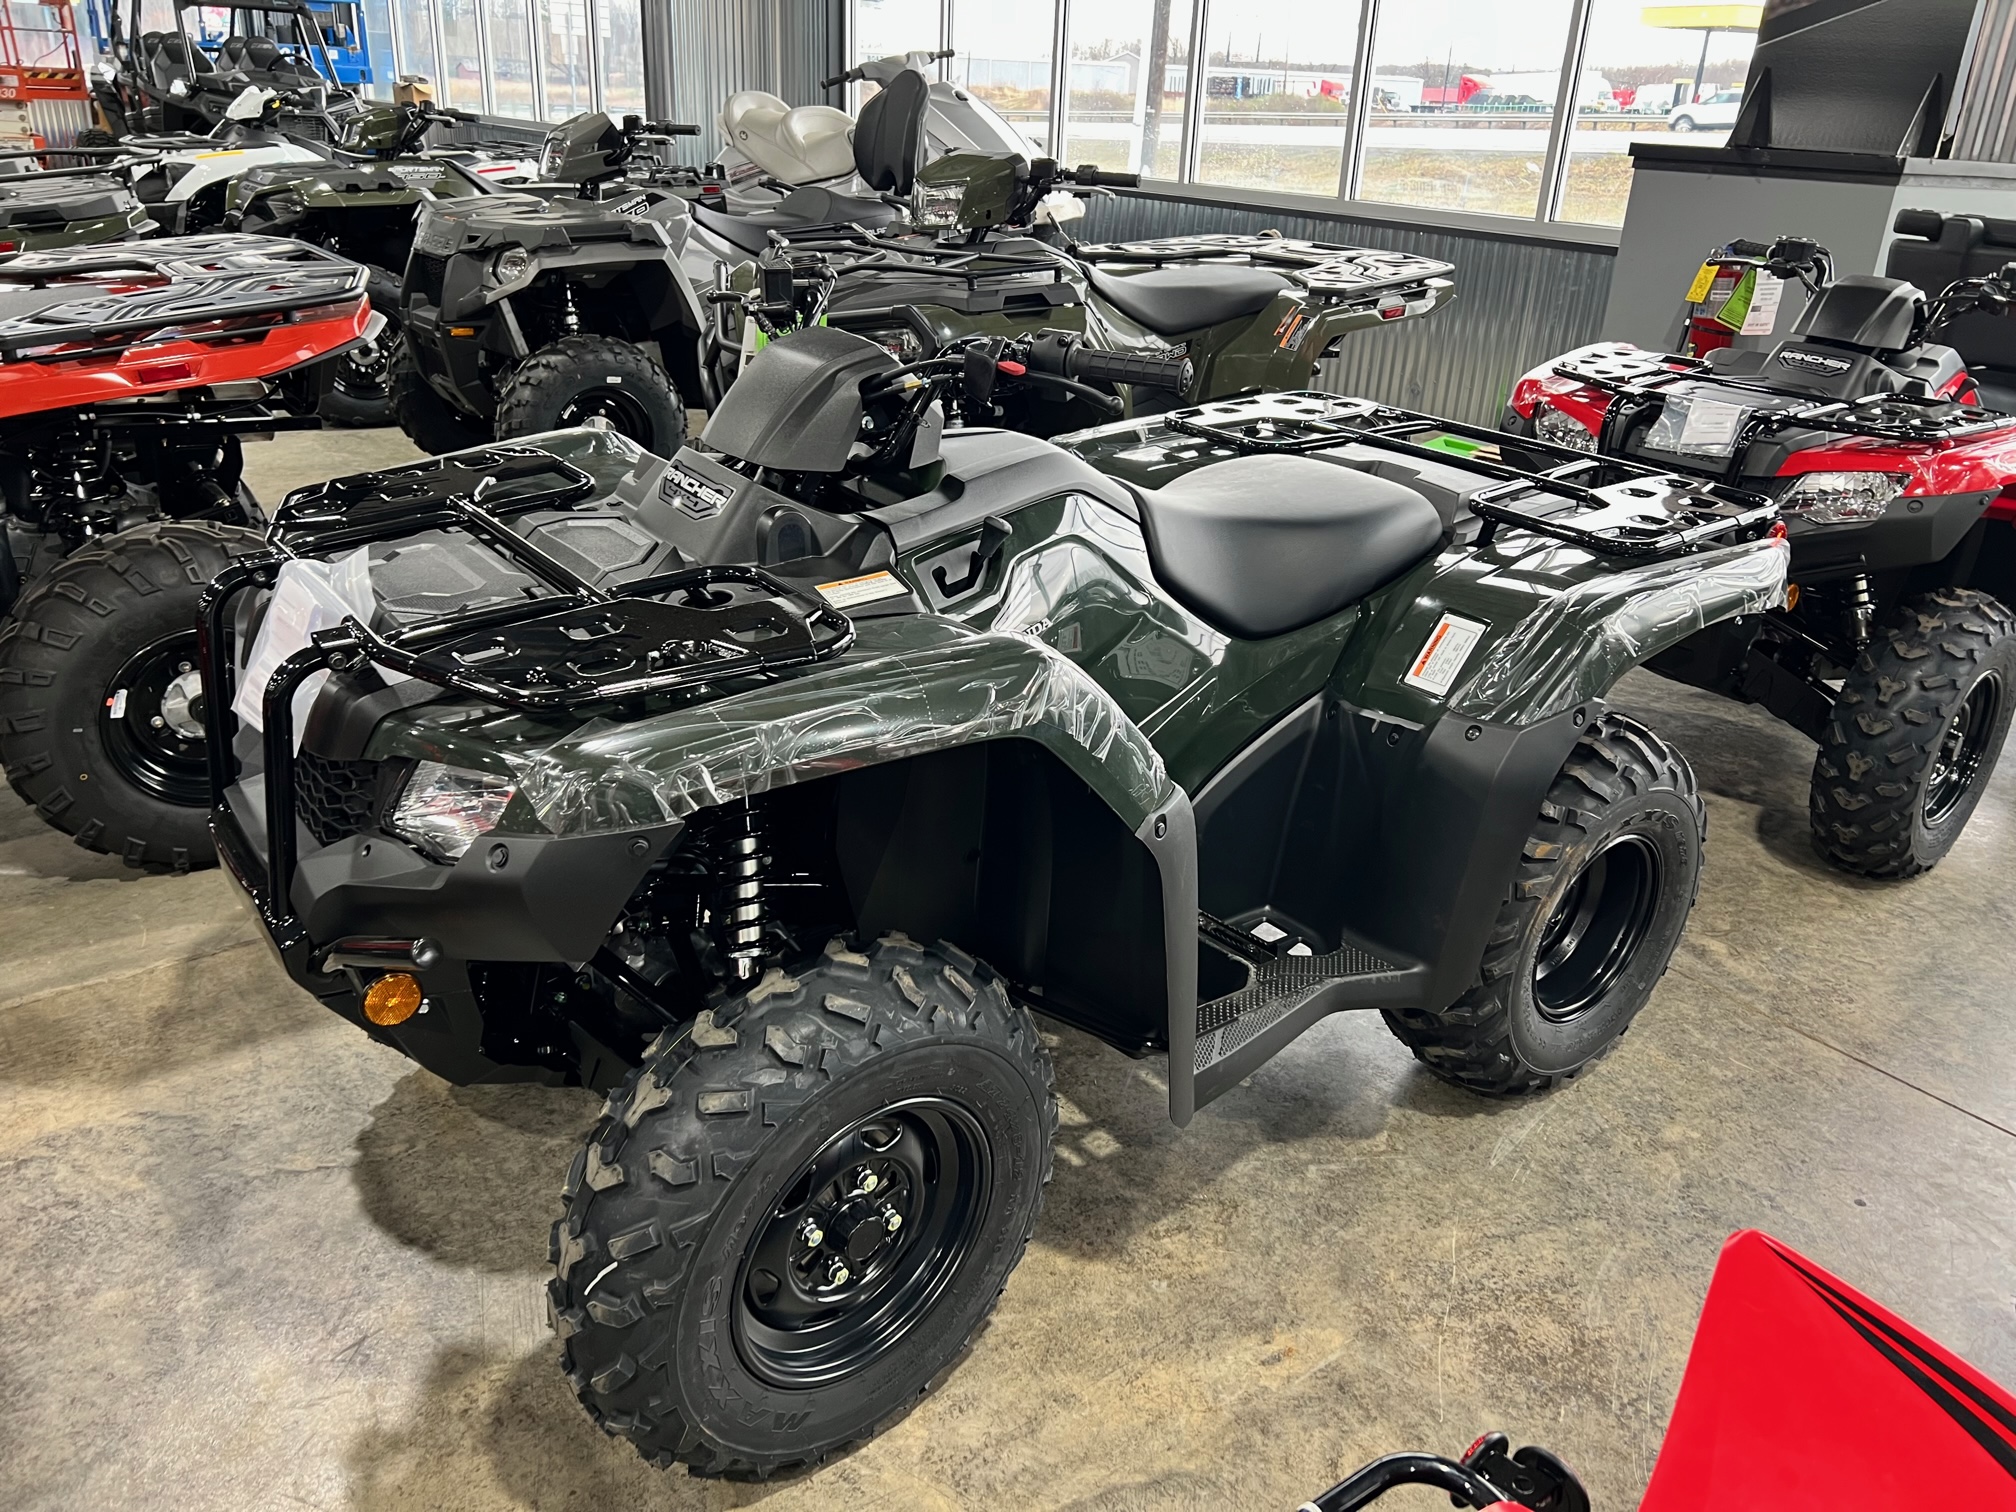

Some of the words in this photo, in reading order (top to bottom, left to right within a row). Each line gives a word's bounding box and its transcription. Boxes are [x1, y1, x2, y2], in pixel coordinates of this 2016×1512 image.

[1779, 351, 1851, 371] RANCHER
[664, 466, 728, 509] RANCHER
[1022, 617, 1053, 636] NDA
